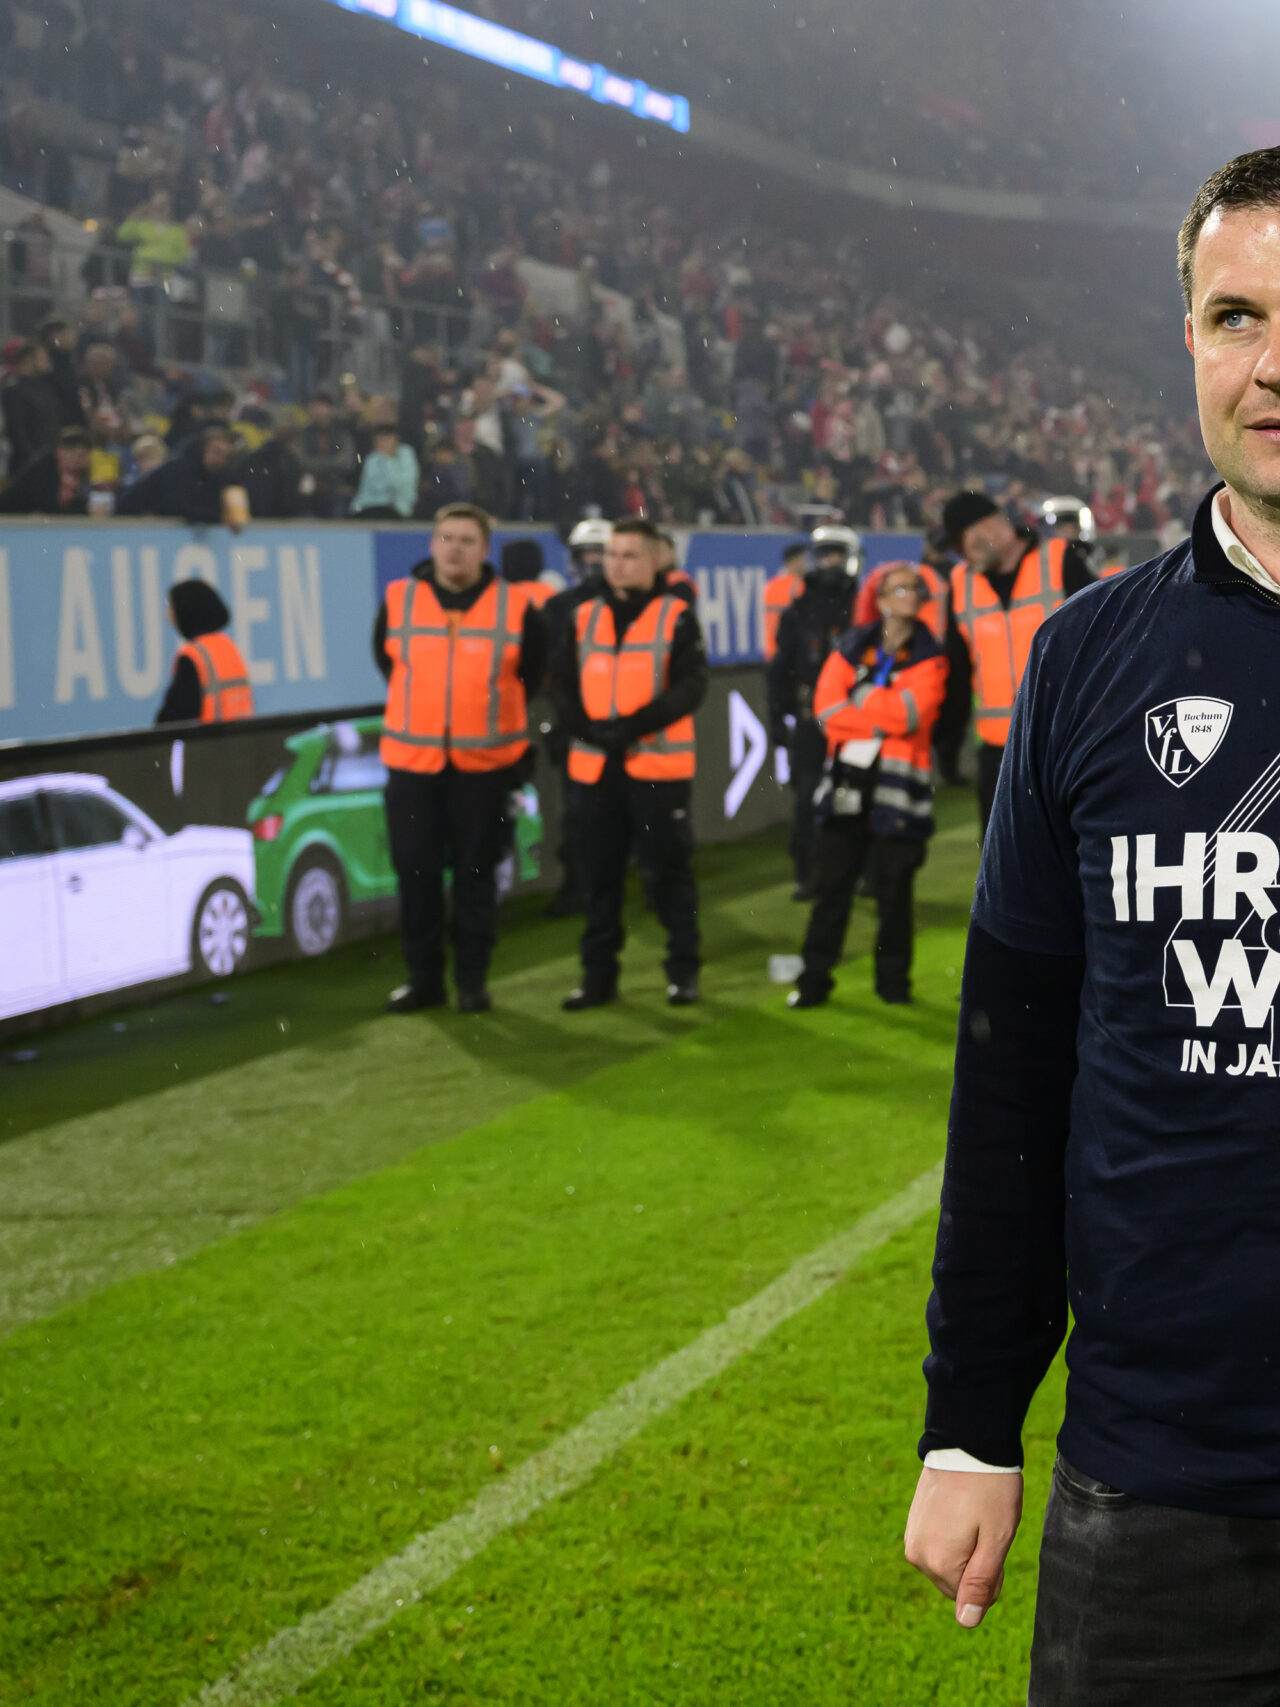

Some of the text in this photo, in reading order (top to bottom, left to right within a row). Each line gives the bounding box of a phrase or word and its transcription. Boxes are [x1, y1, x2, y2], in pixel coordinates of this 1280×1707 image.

[54, 546, 326, 703] AUEN
[1184, 712, 1223, 721] Bochum
[1191, 725, 1212, 733] 1848
[1150, 714, 1192, 774] VfL
[1110, 832, 1280, 922] IHR
[1180, 1039, 1217, 1074] IN
